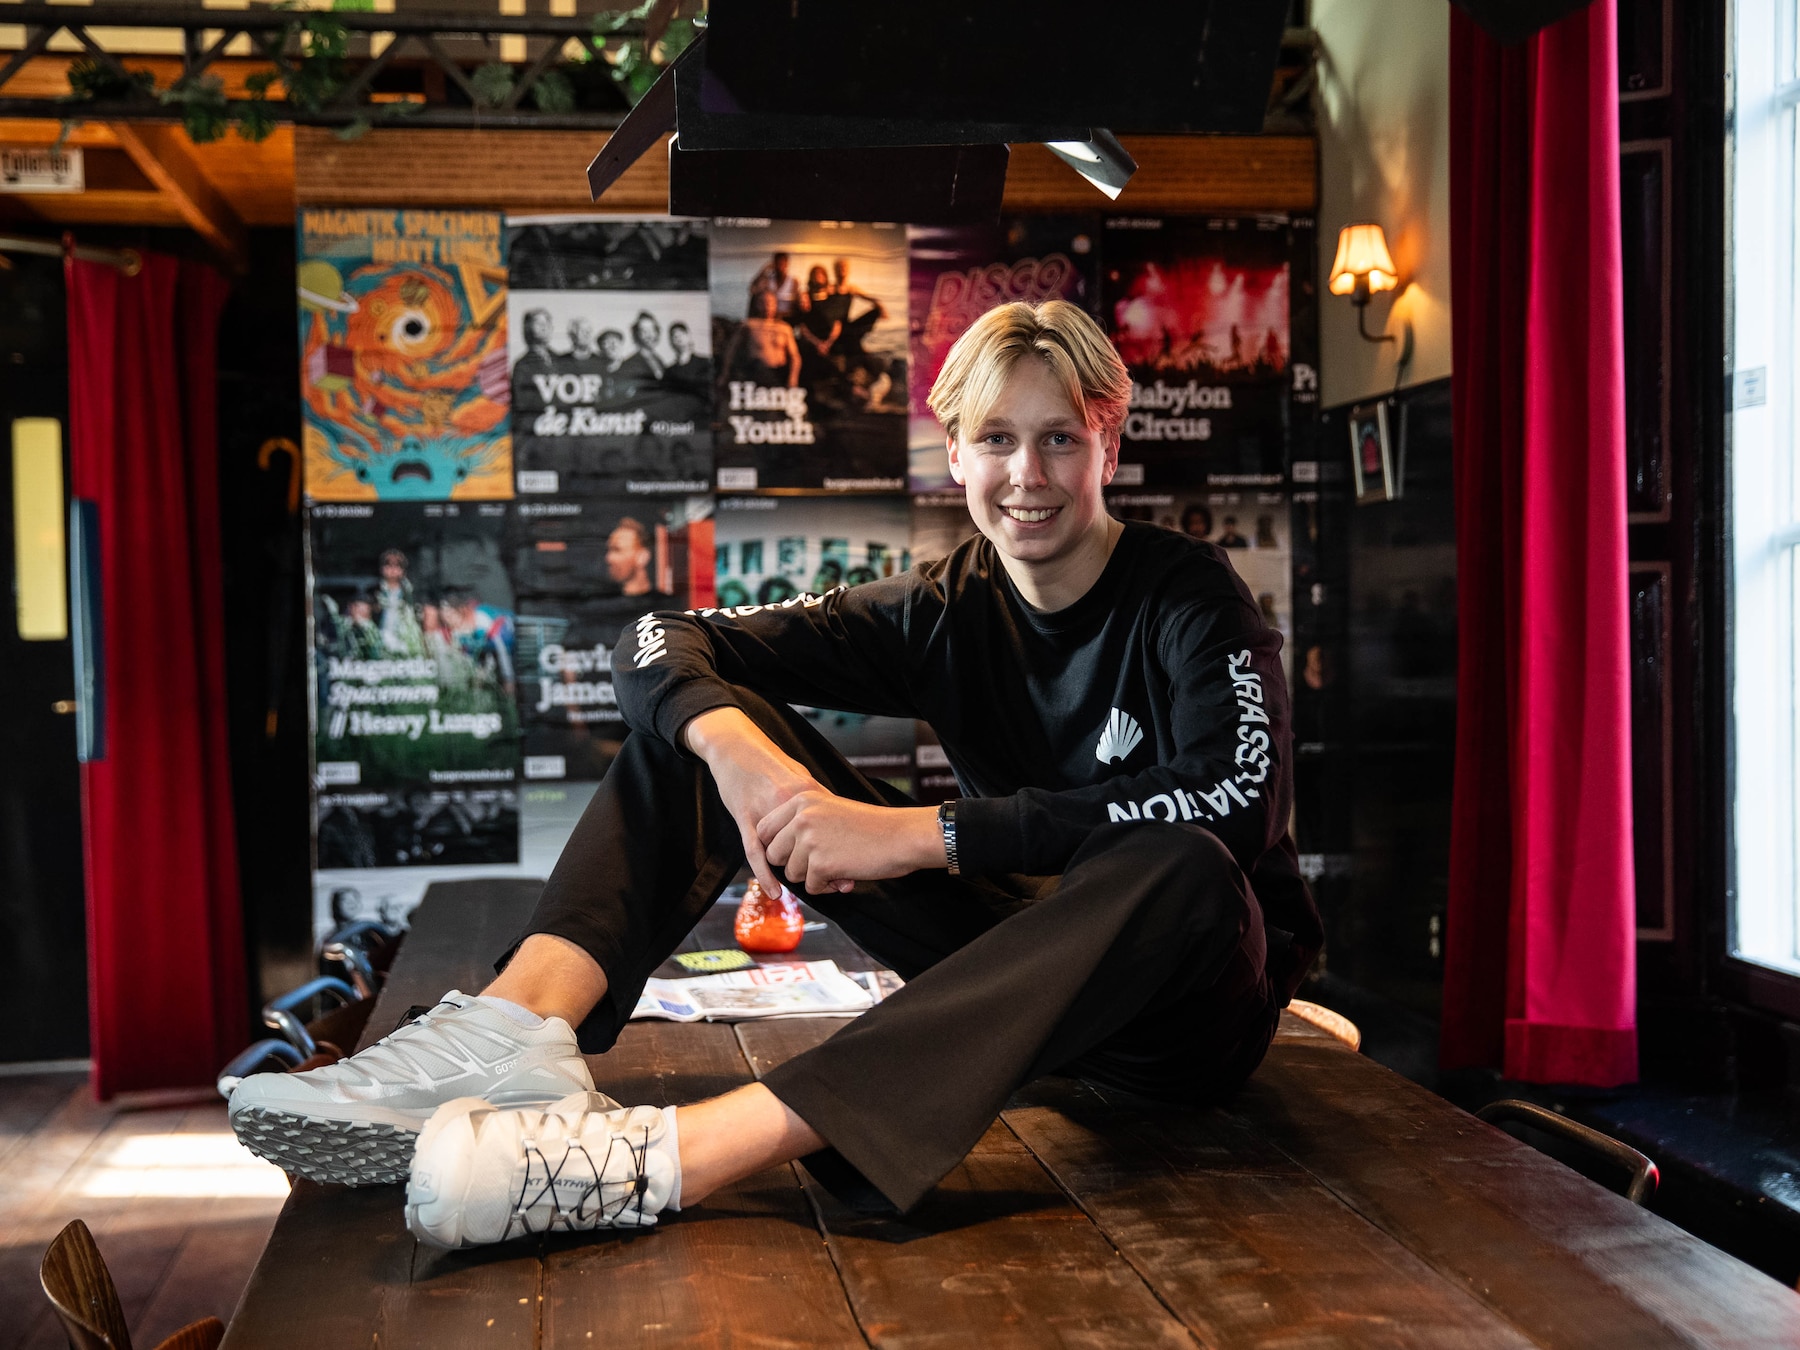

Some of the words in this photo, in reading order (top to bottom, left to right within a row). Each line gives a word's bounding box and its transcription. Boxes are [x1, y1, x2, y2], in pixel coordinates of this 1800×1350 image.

[533, 374, 602, 404] VOF
[729, 381, 807, 419] Hang
[534, 406, 568, 437] de
[569, 407, 647, 437] Kunst
[728, 415, 815, 444] Youth
[1125, 412, 1211, 440] Circus
[633, 612, 667, 669] New
[328, 655, 437, 684] Magnetic
[538, 644, 613, 678] Gavi
[536, 677, 618, 712] Jame
[349, 709, 427, 740] Heavy
[428, 708, 502, 740] Lungs
